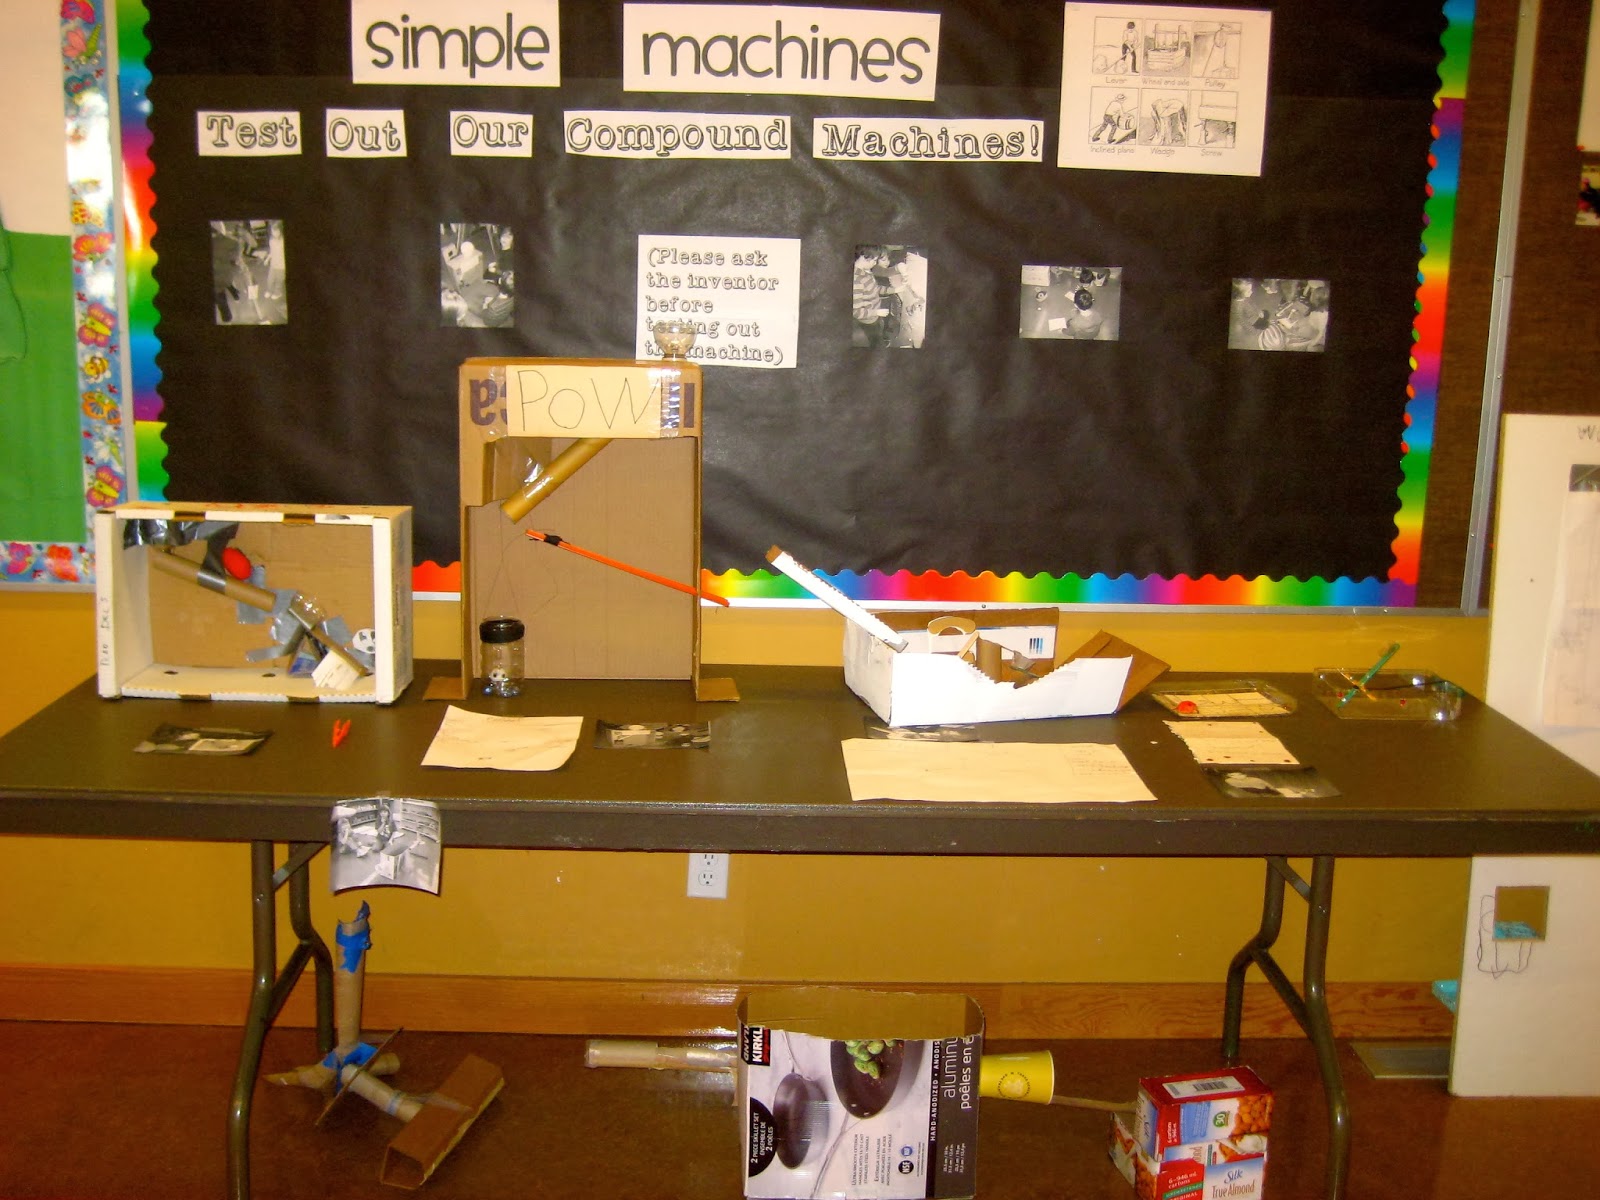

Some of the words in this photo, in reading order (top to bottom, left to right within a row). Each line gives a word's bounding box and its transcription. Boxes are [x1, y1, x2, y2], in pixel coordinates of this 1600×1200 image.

[366, 13, 550, 79] simple
[643, 20, 931, 85] machines
[207, 114, 298, 149] Test
[328, 117, 401, 152] Out
[453, 114, 529, 148] Our
[566, 118, 788, 157] Compound
[822, 123, 1041, 158] Machines!
[647, 247, 725, 267] (Please
[731, 250, 768, 266] ask
[646, 272, 681, 288] the
[687, 273, 779, 290] inventor
[645, 296, 714, 312] before
[726, 321, 761, 337] out
[686, 344, 784, 366] machine)
[962, 1047, 972, 1064] en
[958, 1067, 972, 1110] poêles
[1215, 1113, 1226, 1126] 30
[1223, 1169, 1244, 1184] Silk
[1212, 1184, 1228, 1199] True
[1227, 1180, 1256, 1198] Almond
